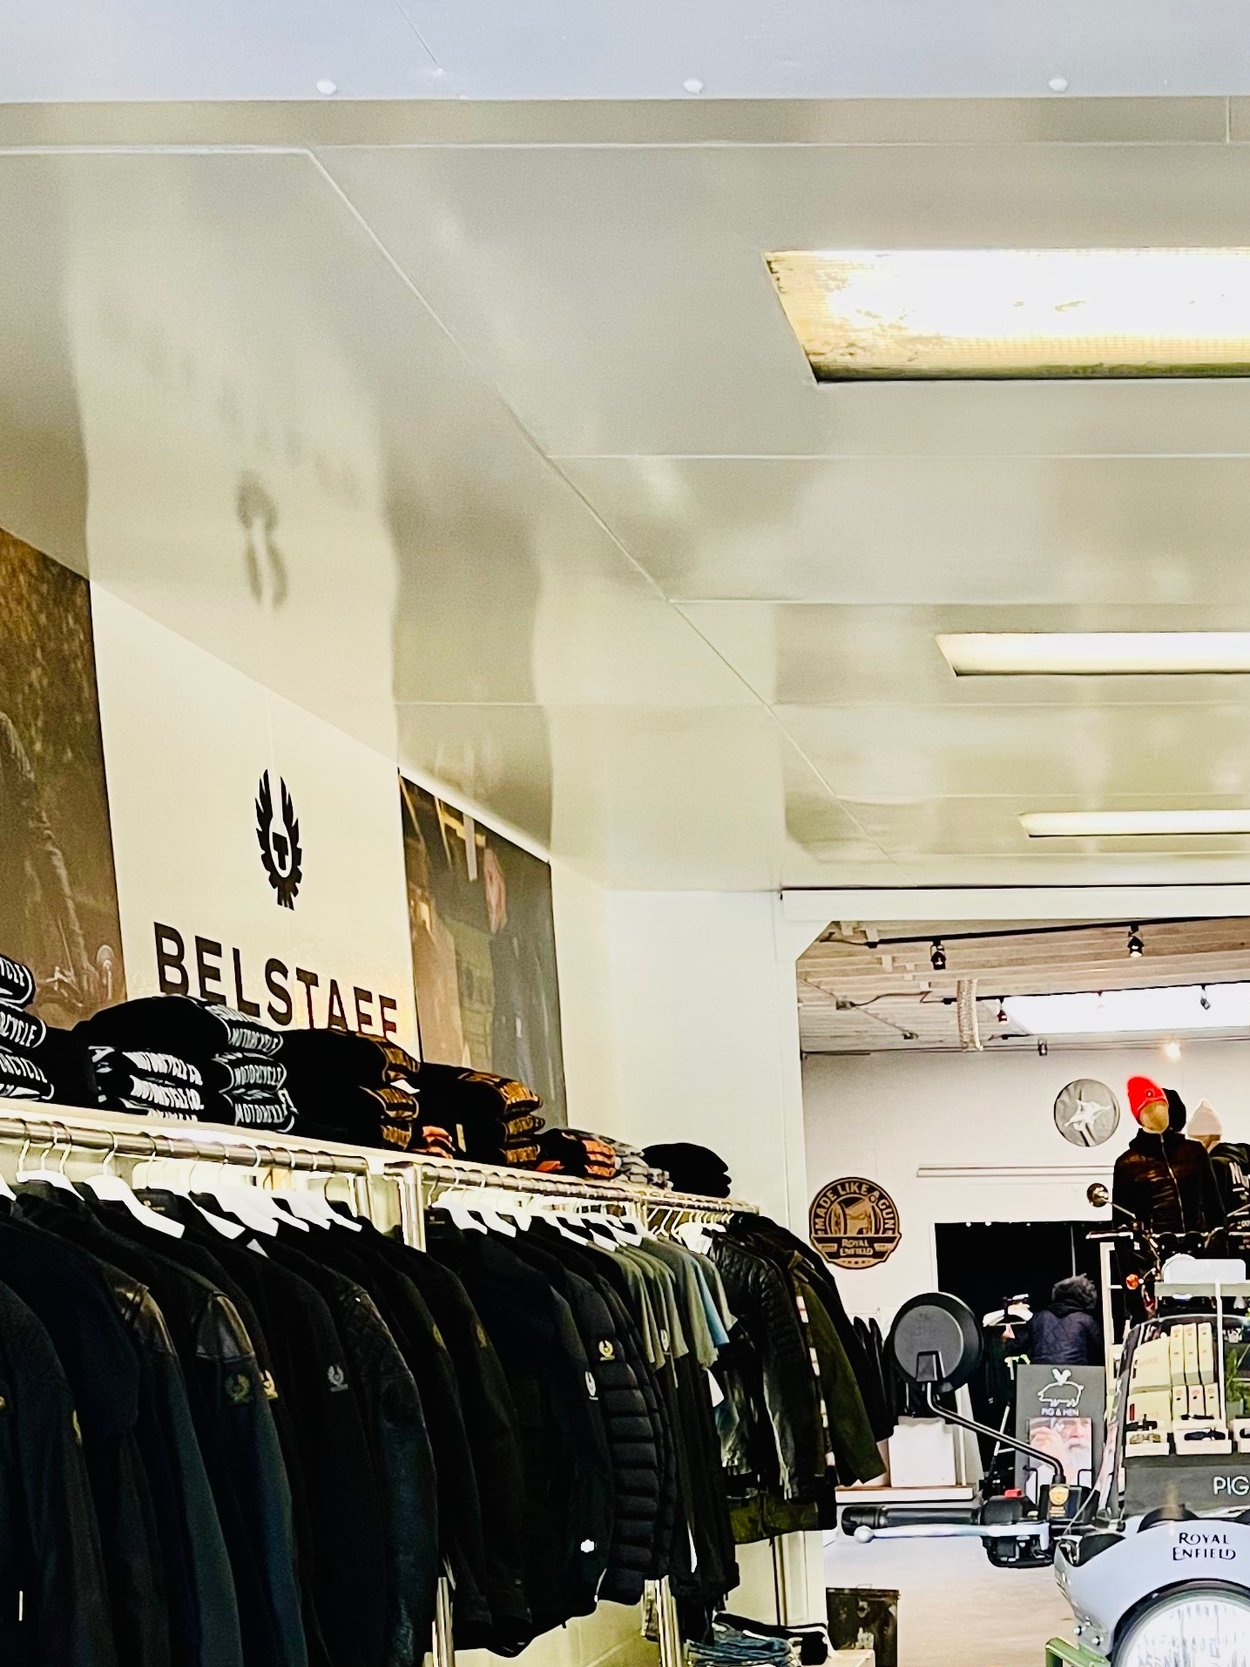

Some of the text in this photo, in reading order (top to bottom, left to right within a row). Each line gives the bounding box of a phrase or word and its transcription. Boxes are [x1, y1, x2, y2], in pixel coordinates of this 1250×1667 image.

[154, 921, 397, 1040] BELSTAFF
[815, 1190, 837, 1230] MADE
[837, 1182, 869, 1196] LIKE
[878, 1198, 896, 1229] GUN
[841, 1238, 869, 1248] ROYAL
[840, 1247, 874, 1257] ENFIELD
[1213, 1475, 1250, 1496] PIG
[1178, 1532, 1231, 1546] ROYAL
[1172, 1546, 1236, 1561] ENFIELD
